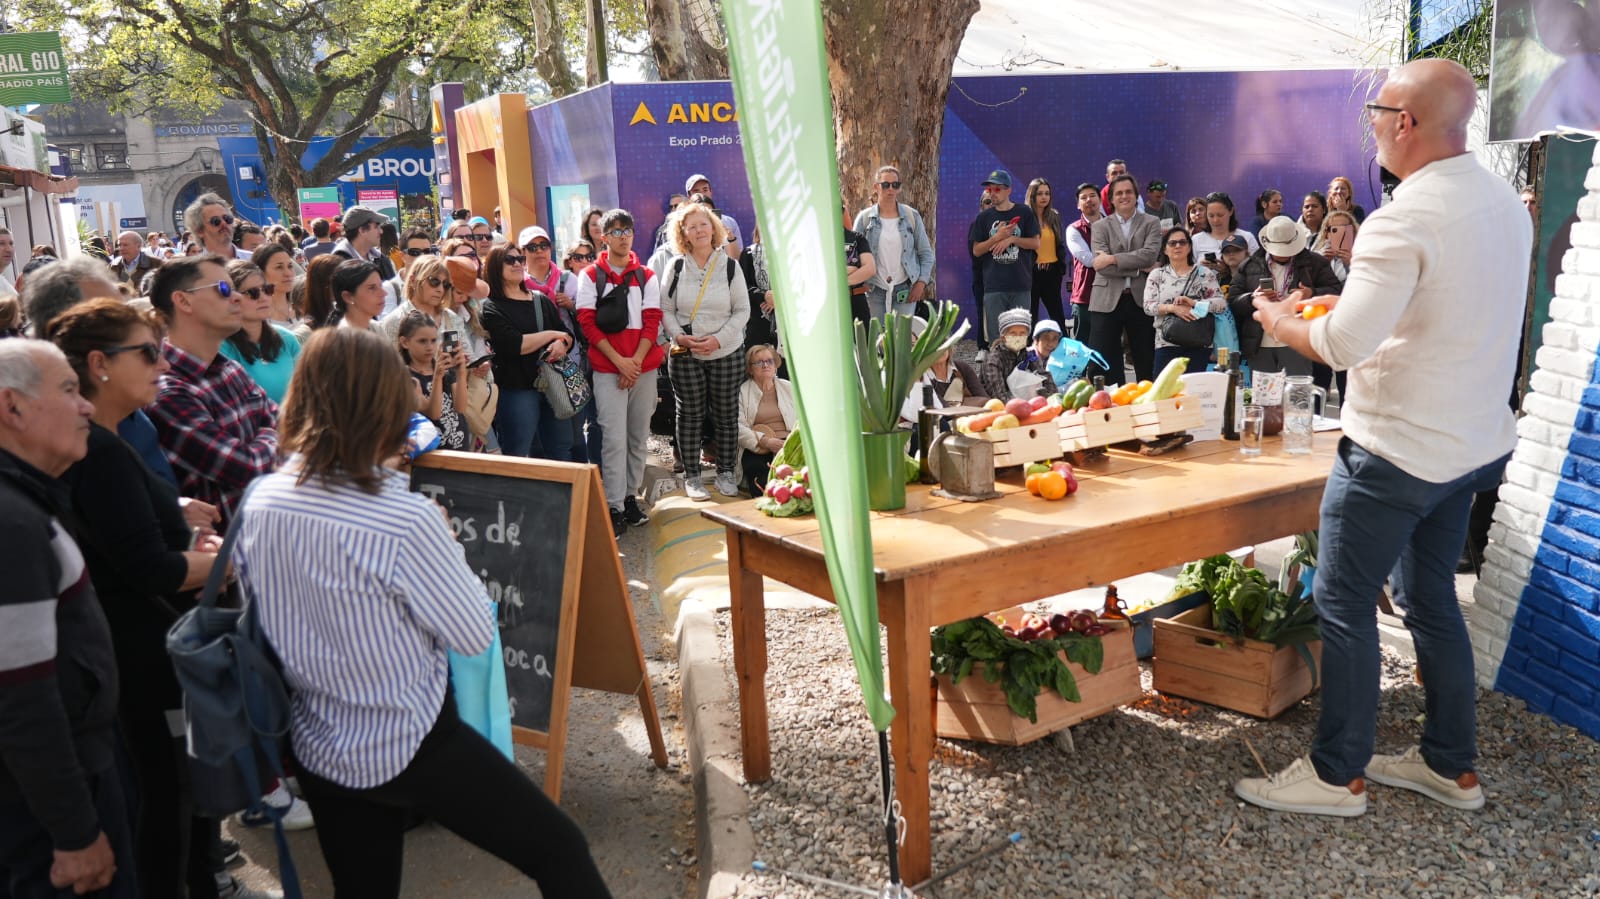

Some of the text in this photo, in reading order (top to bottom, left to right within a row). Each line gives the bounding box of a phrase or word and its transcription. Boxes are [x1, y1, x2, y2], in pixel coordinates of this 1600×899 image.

[31, 51, 60, 71] 610
[0, 76, 64, 88] RADIO PAÍS
[168, 124, 240, 135] BOVINOS
[669, 136, 697, 147] Expo
[700, 135, 733, 145] Prado
[368, 158, 436, 177] BROU
[485, 500, 521, 546] de
